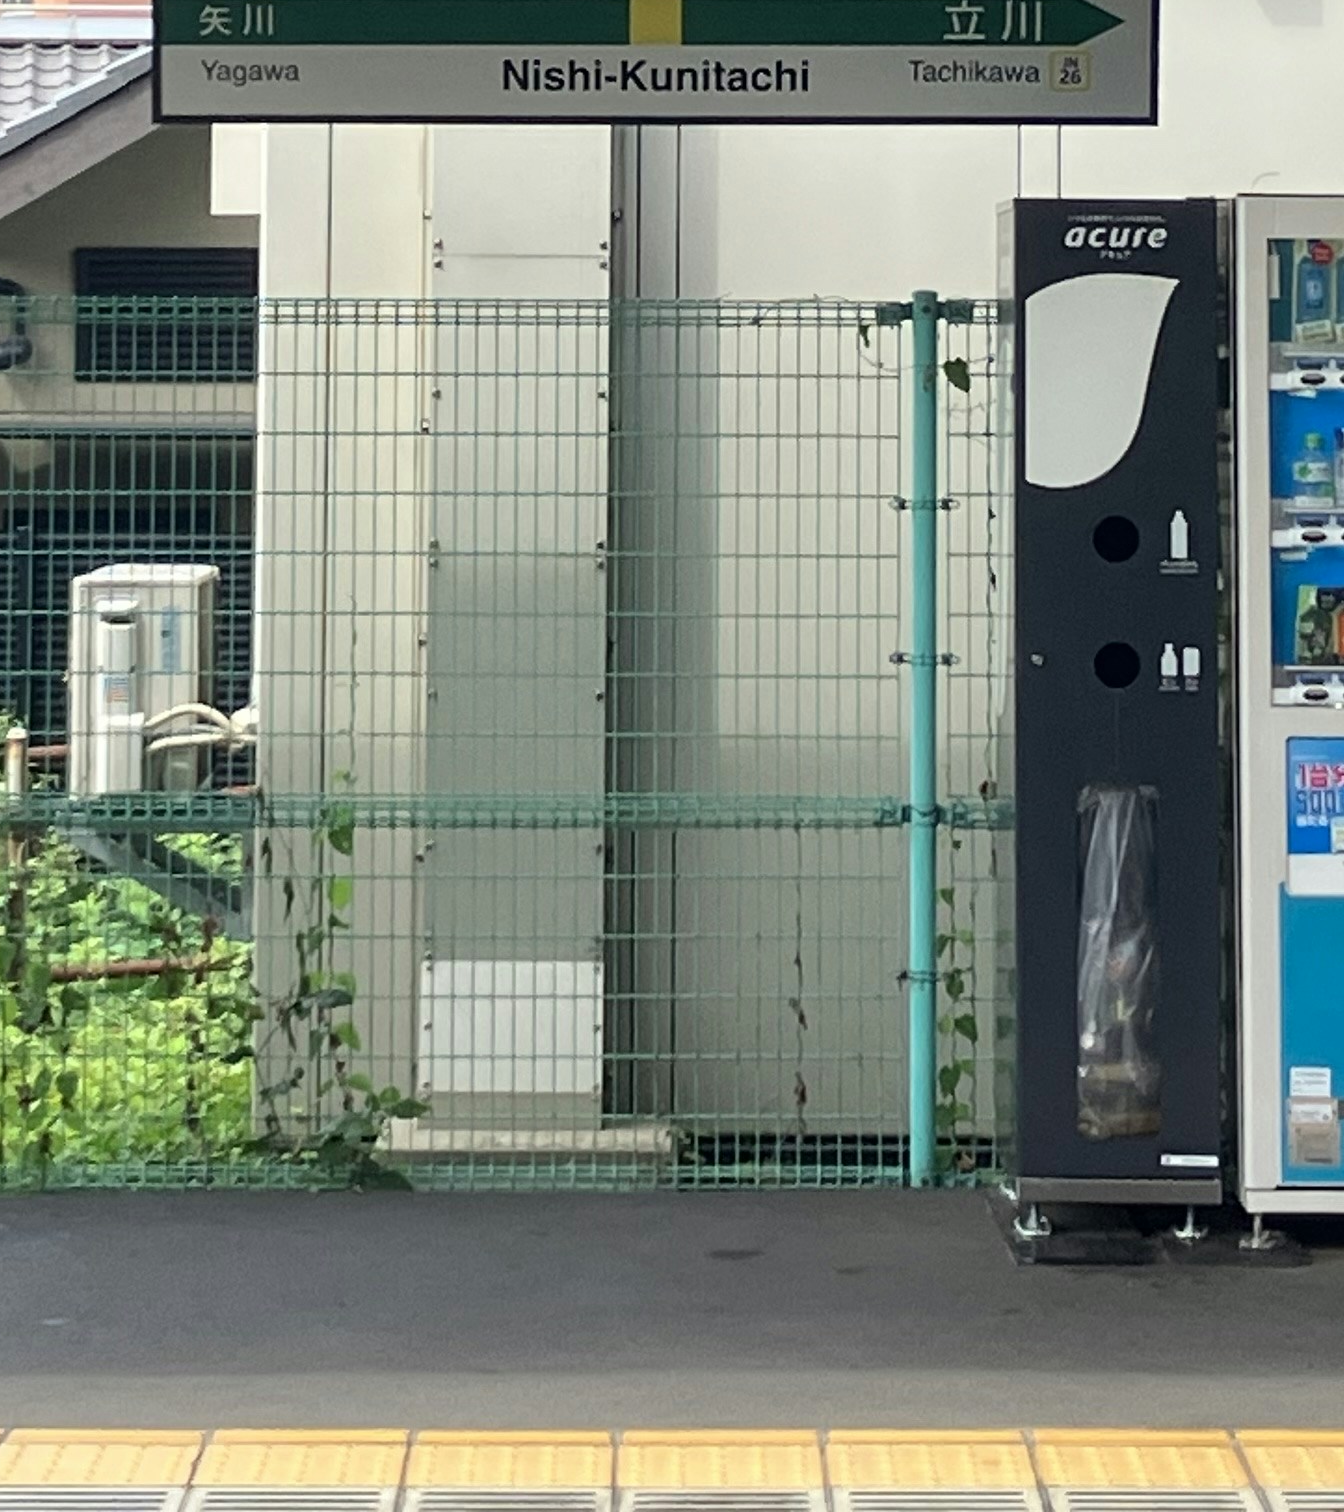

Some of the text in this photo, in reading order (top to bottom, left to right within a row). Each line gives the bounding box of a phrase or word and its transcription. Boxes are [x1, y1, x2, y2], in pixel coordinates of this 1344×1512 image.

[198, 3, 275, 37] 矢川
[942, 0, 1044, 43] 立川
[200, 58, 301, 88] Yagawa
[500, 57, 811, 93] Nishi-Kunitachi
[908, 58, 1042, 84] Tachikawa
[1058, 68, 1083, 85] 26
[1063, 226, 1169, 249] acure
